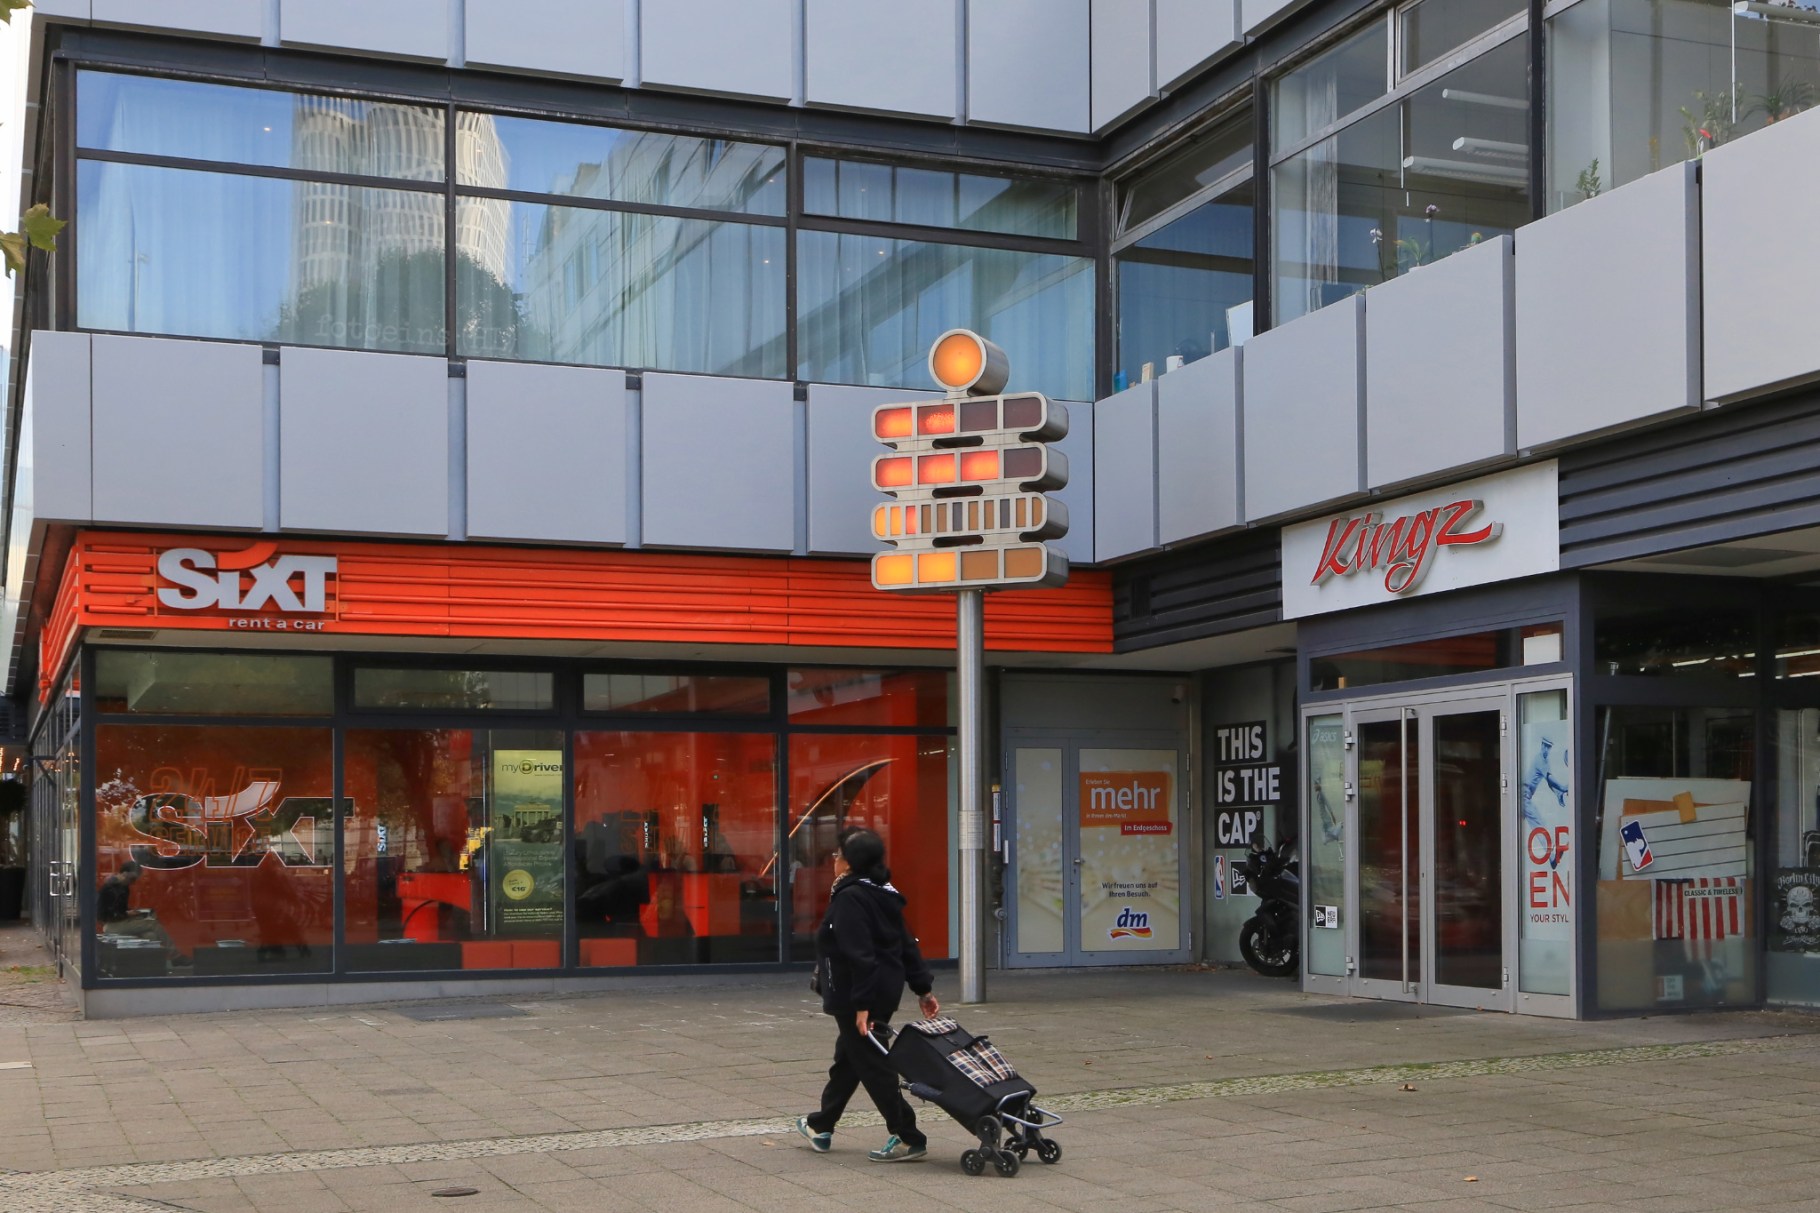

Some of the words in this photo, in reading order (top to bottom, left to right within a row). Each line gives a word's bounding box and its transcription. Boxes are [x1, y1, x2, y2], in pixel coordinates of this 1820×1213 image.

[1311, 499, 1499, 594] Kingz
[229, 617, 271, 629] rent
[276, 619, 287, 630] a
[293, 620, 325, 630] car
[1217, 725, 1263, 761] THIS
[1090, 780, 1161, 810] mehr
[1217, 769, 1236, 803] IS
[1240, 766, 1281, 802] THE
[1530, 870, 1570, 908] EN
[1684, 889, 1707, 897] CLASSIC
[1117, 907, 1148, 928] dm
[1530, 914, 1550, 923] YOUR
